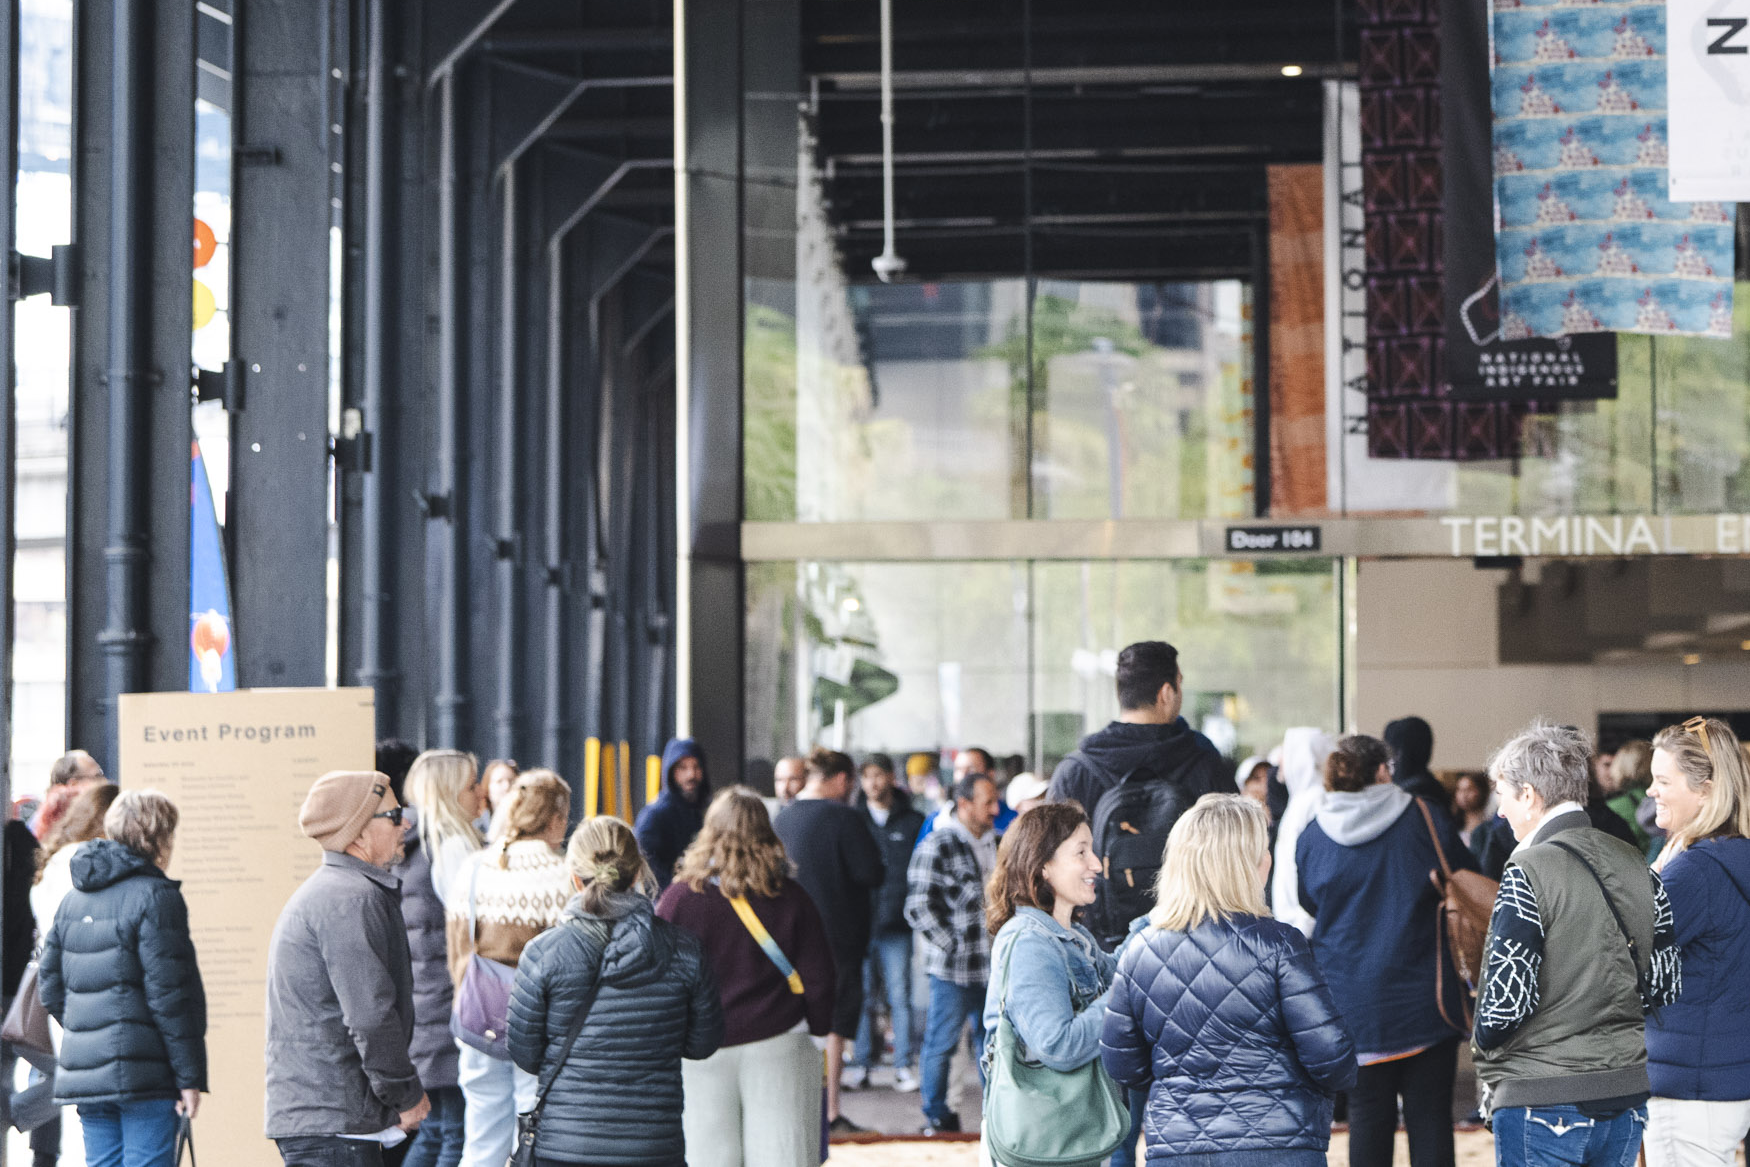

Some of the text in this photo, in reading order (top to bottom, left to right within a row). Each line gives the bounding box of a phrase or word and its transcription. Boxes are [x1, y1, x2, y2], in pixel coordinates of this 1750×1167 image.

[1230, 529, 1278, 549] Door
[1440, 515, 1687, 556] TERMINAL
[143, 723, 317, 743] Event Program
